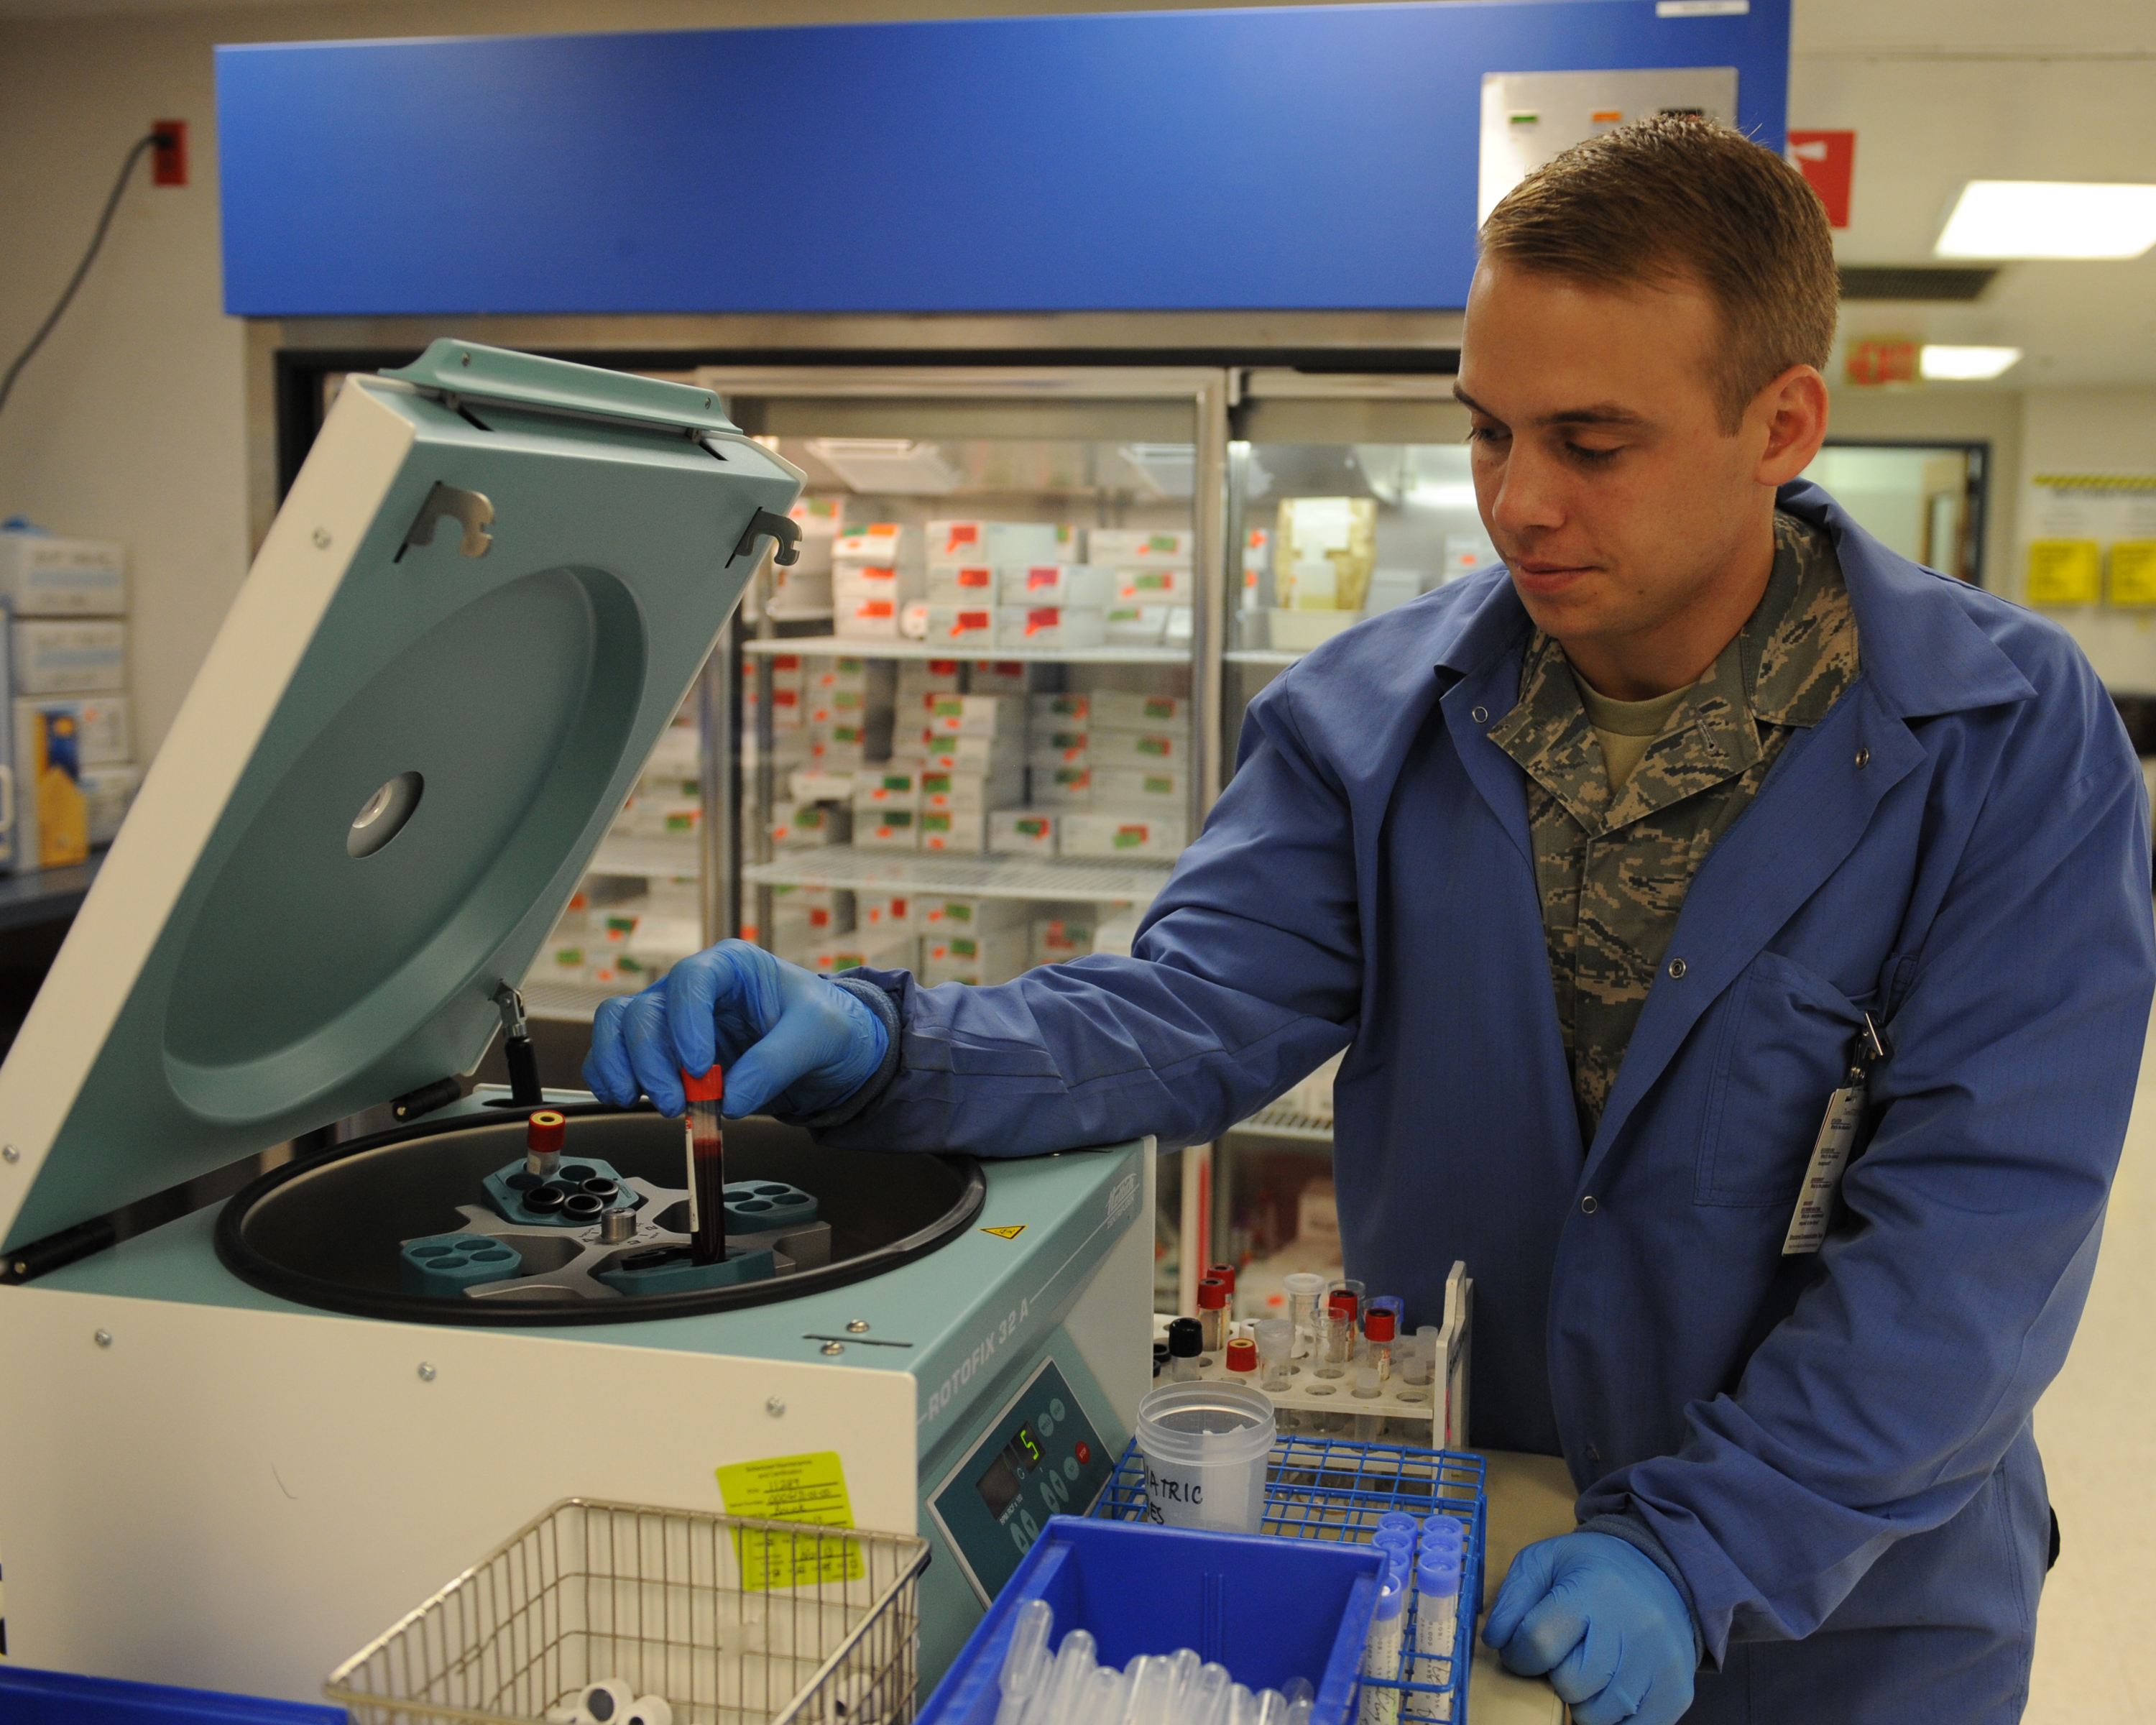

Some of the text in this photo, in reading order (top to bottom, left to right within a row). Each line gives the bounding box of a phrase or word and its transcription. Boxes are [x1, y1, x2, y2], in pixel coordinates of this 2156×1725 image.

[929, 1297, 1028, 1422] ROTOFIX 32 A
[1020, 1430, 1039, 1460] 5
